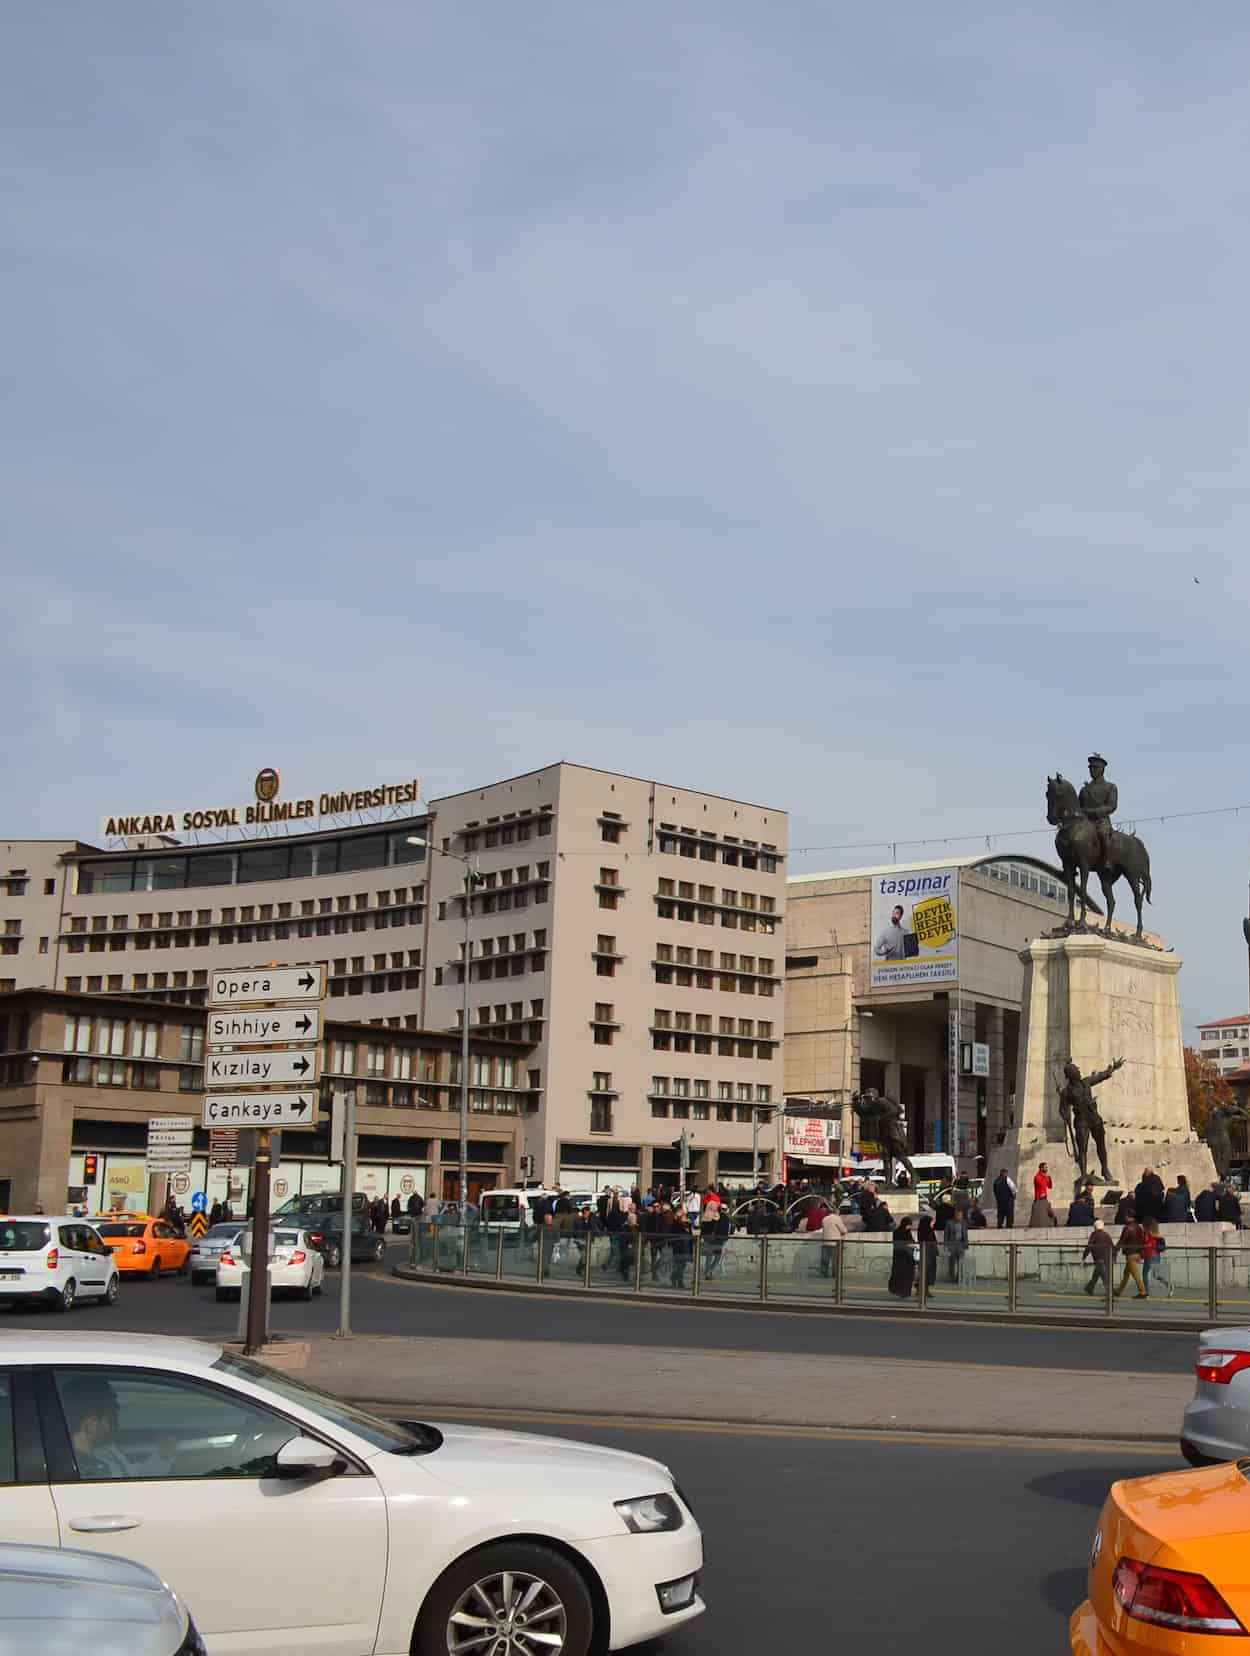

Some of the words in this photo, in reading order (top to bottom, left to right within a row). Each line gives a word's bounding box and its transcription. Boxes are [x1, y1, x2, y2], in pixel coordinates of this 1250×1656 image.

[105, 814, 175, 836] ANKARA
[183, 808, 239, 830] SOSYAL
[245, 800, 314, 824] BİLİMLER
[319, 779, 418, 815] ÜNİVERSİTESİ
[880, 874, 951, 896] taşpınar
[216, 979, 271, 998] Opera
[213, 1018, 281, 1037] Sıhhiye
[211, 1059, 272, 1078] Kızılay
[208, 1101, 282, 1120] Çankaya
